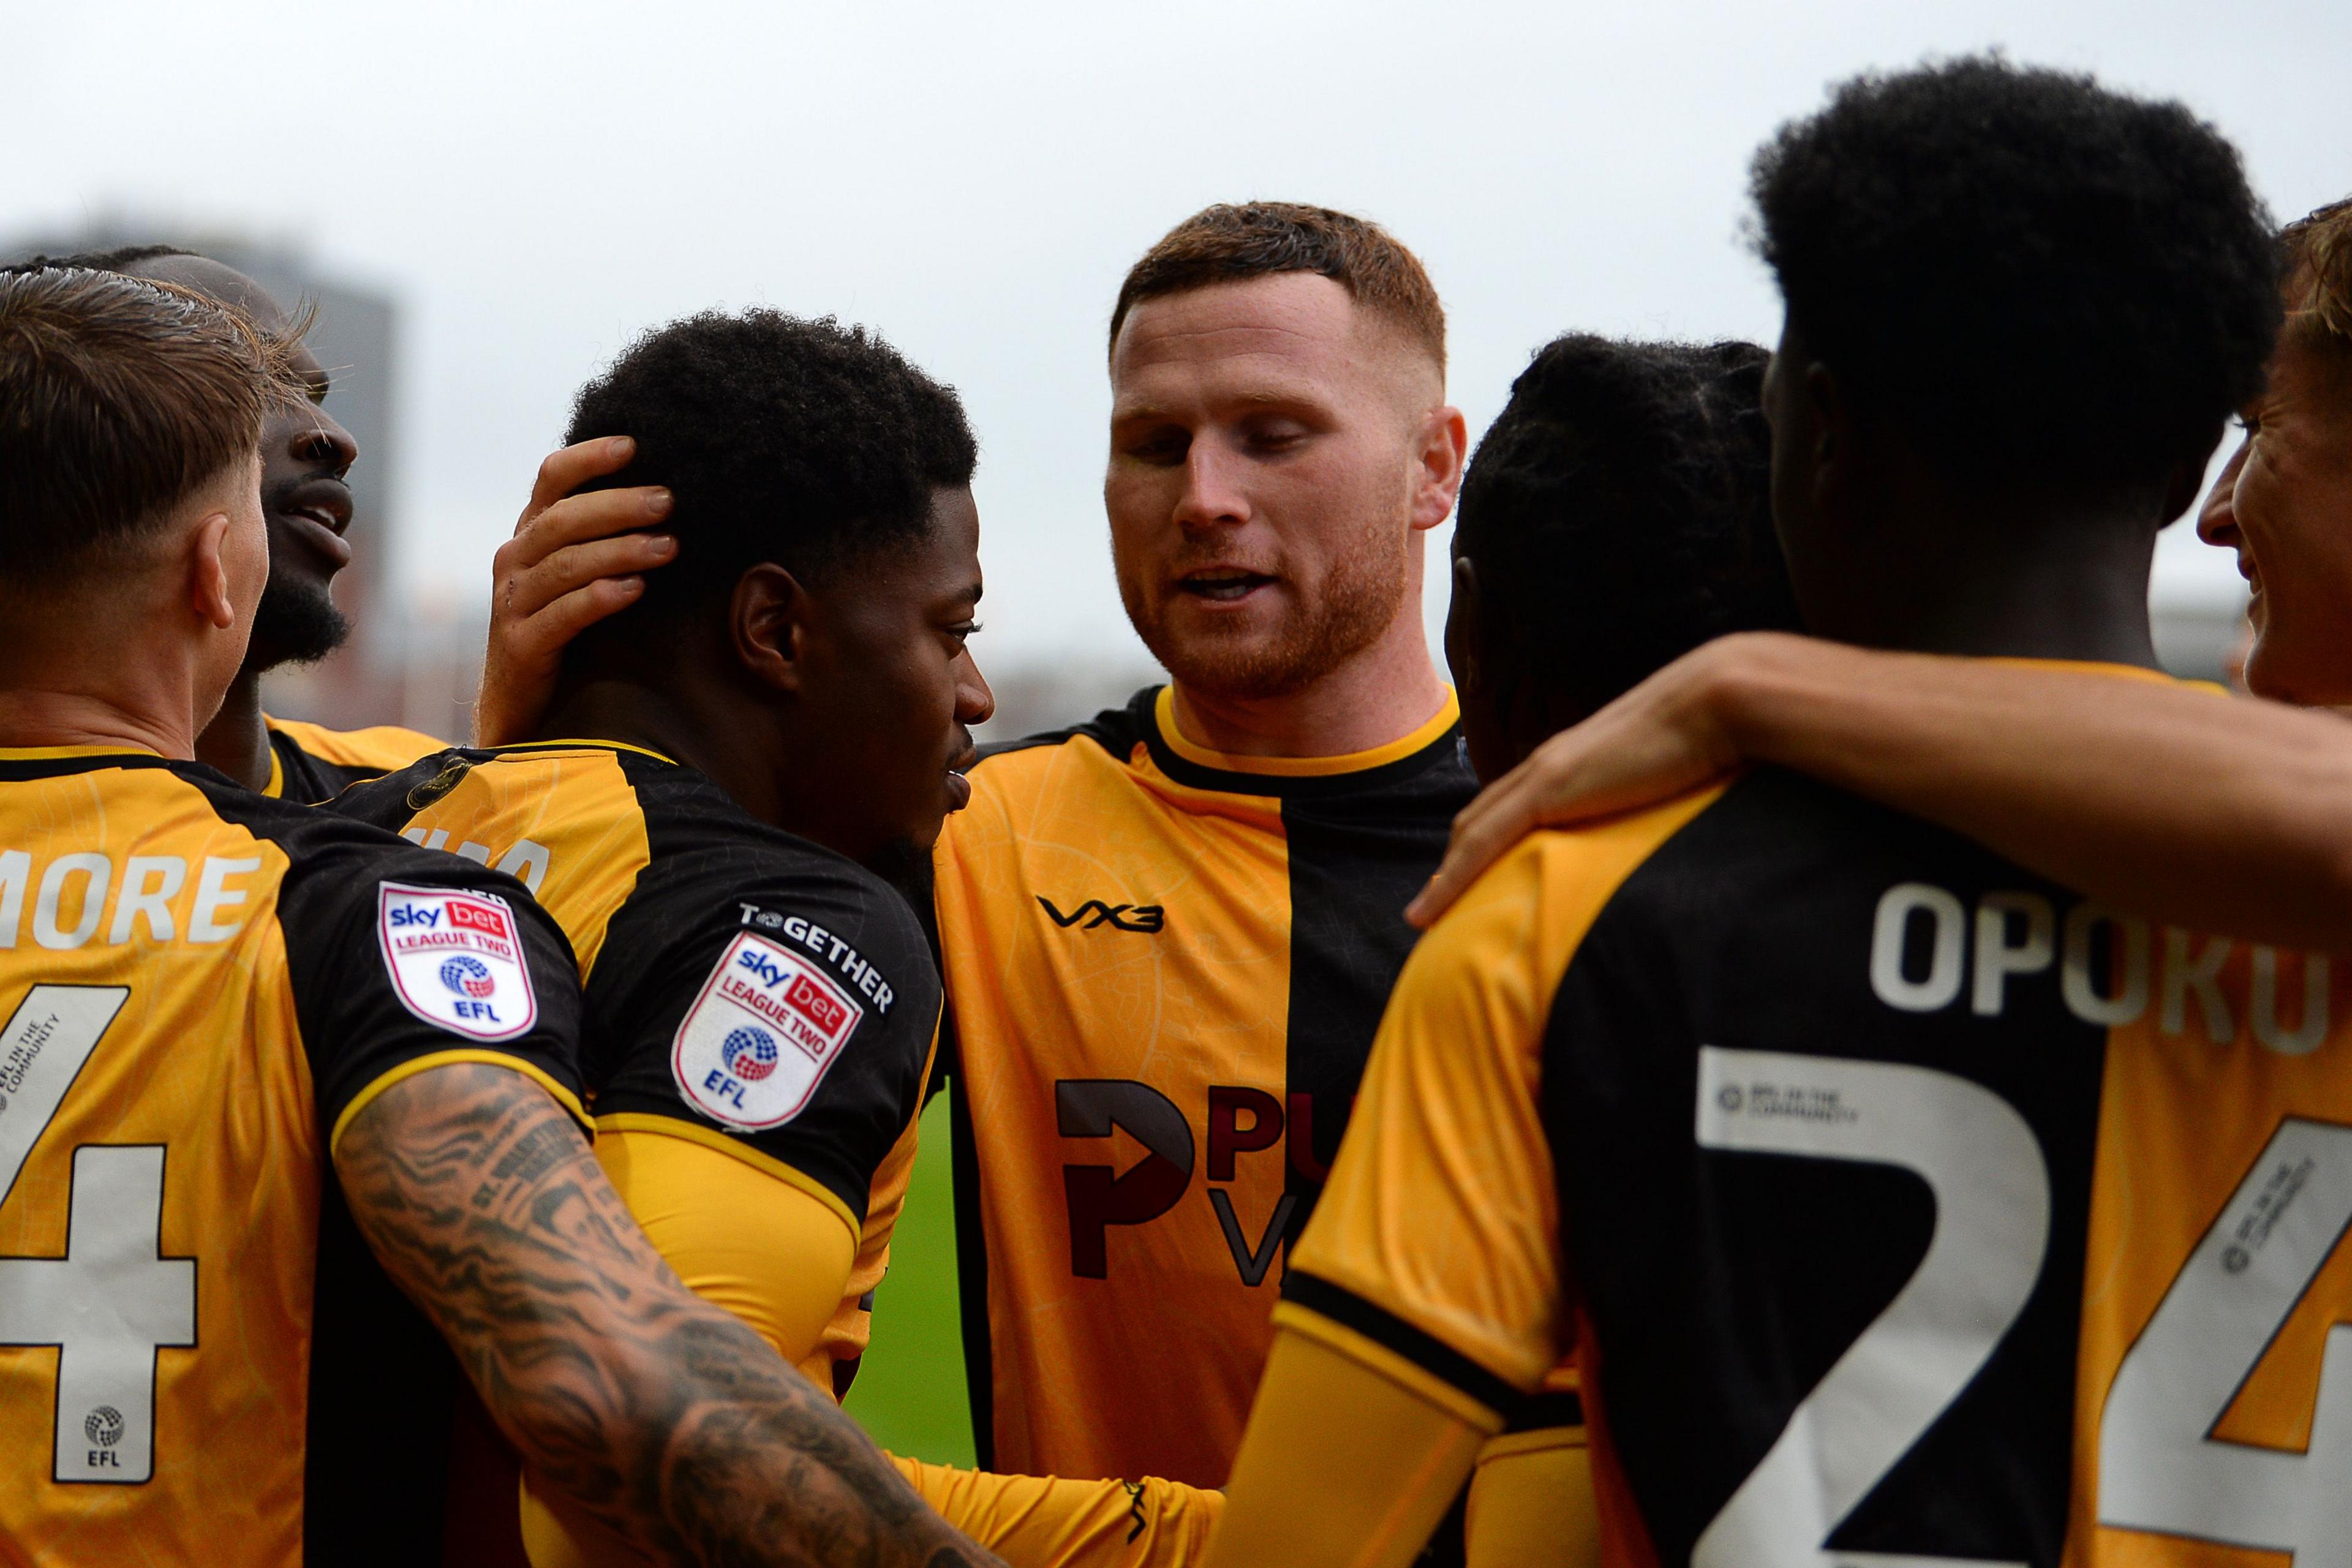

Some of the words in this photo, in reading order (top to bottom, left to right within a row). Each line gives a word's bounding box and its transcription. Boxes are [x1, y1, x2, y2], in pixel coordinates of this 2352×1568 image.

[391, 903, 440, 928] sky
[451, 903, 502, 932] bet
[1036, 894, 1164, 933] VX3
[396, 932, 470, 949] LEAGUE
[474, 935, 511, 957] TWO
[737, 949, 791, 989] sky
[792, 978, 842, 1028] bet
[1869, 882, 2329, 1056] OPOKU
[454, 1000, 501, 1023] EFL
[722, 975, 791, 1027] LEAGUE
[790, 1017, 827, 1056] TWO
[6, 1012, 59, 1094] COMMUNITY
[9, 1046, 24, 1063] IN
[18, 1020, 41, 1045] THE
[704, 1068, 746, 1110] EFL
[88, 1450, 120, 1467] EFL
